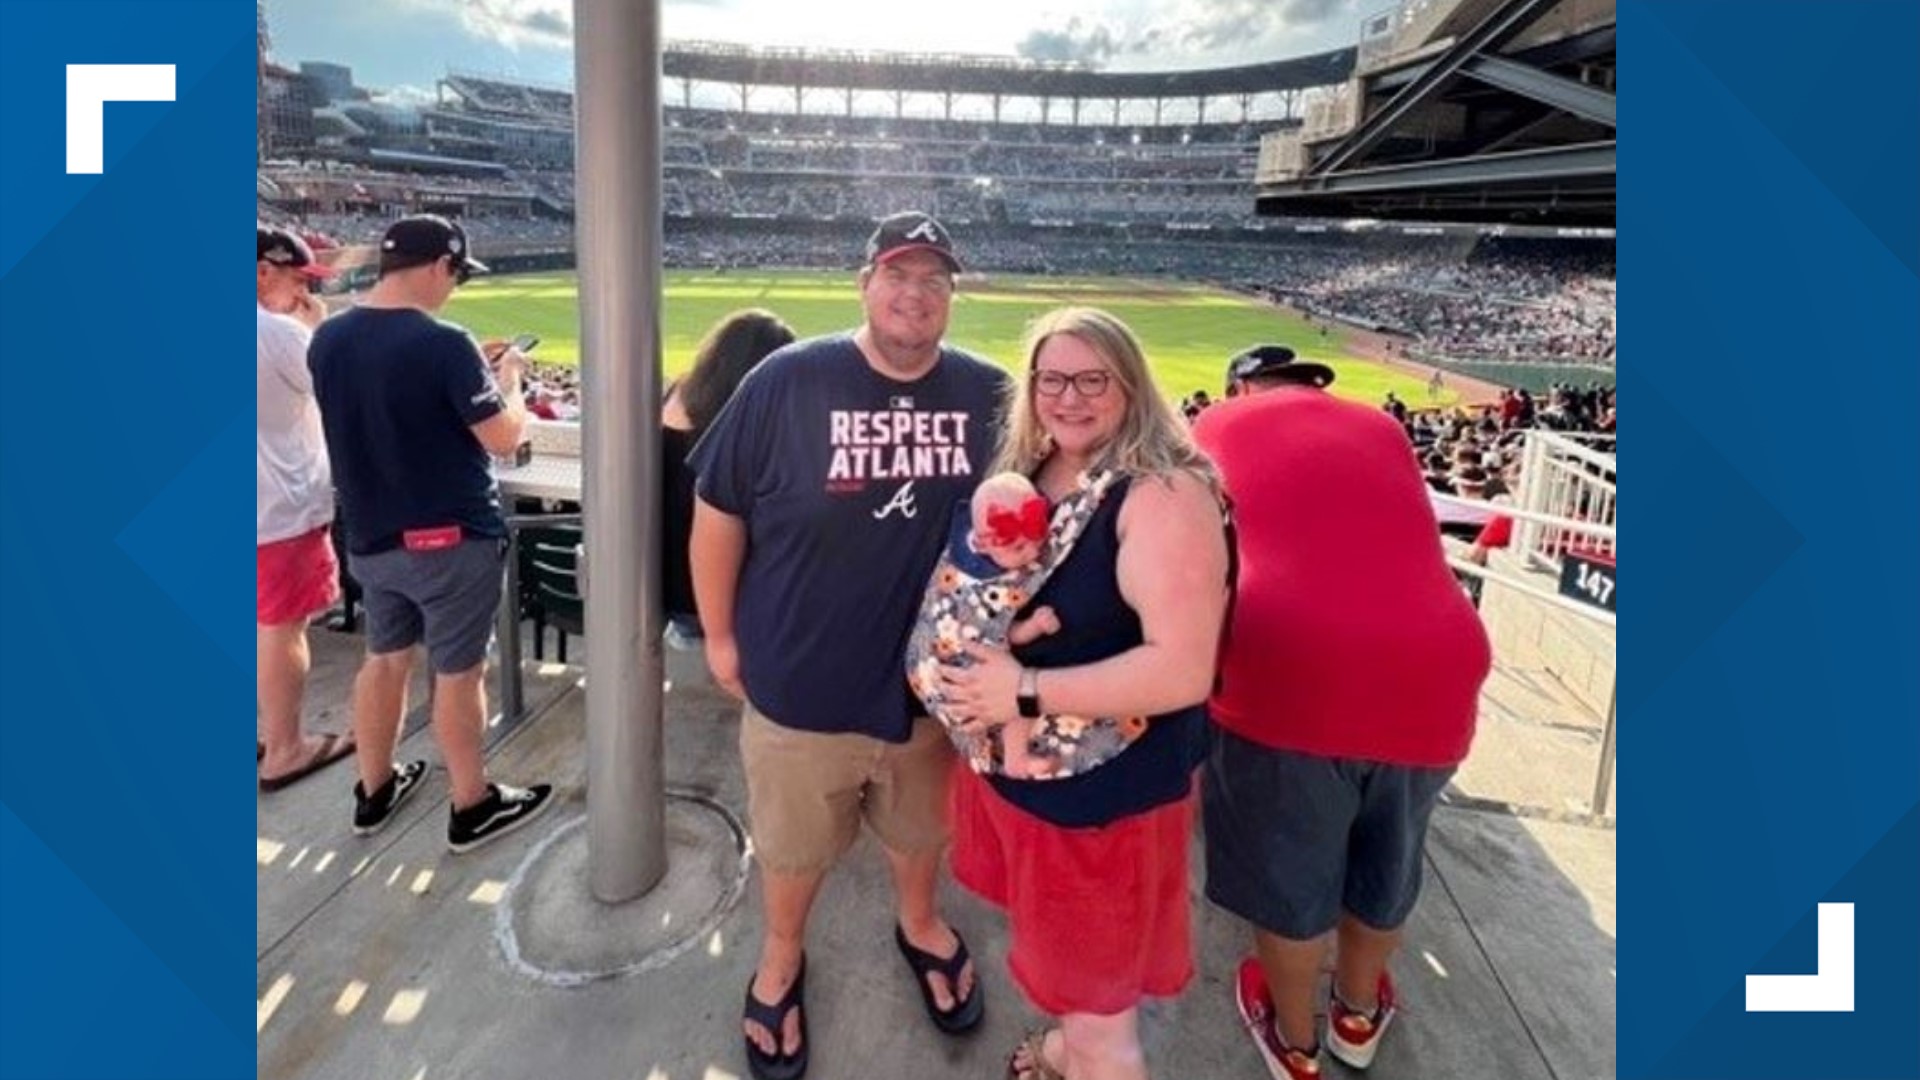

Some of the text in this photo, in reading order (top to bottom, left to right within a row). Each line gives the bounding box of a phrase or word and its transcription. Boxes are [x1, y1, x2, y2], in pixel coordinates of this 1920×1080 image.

[830, 410, 969, 445] RESPECT
[827, 446, 971, 479] ATLANTA
[872, 480, 917, 519] A
[1576, 562, 1615, 605] 147
